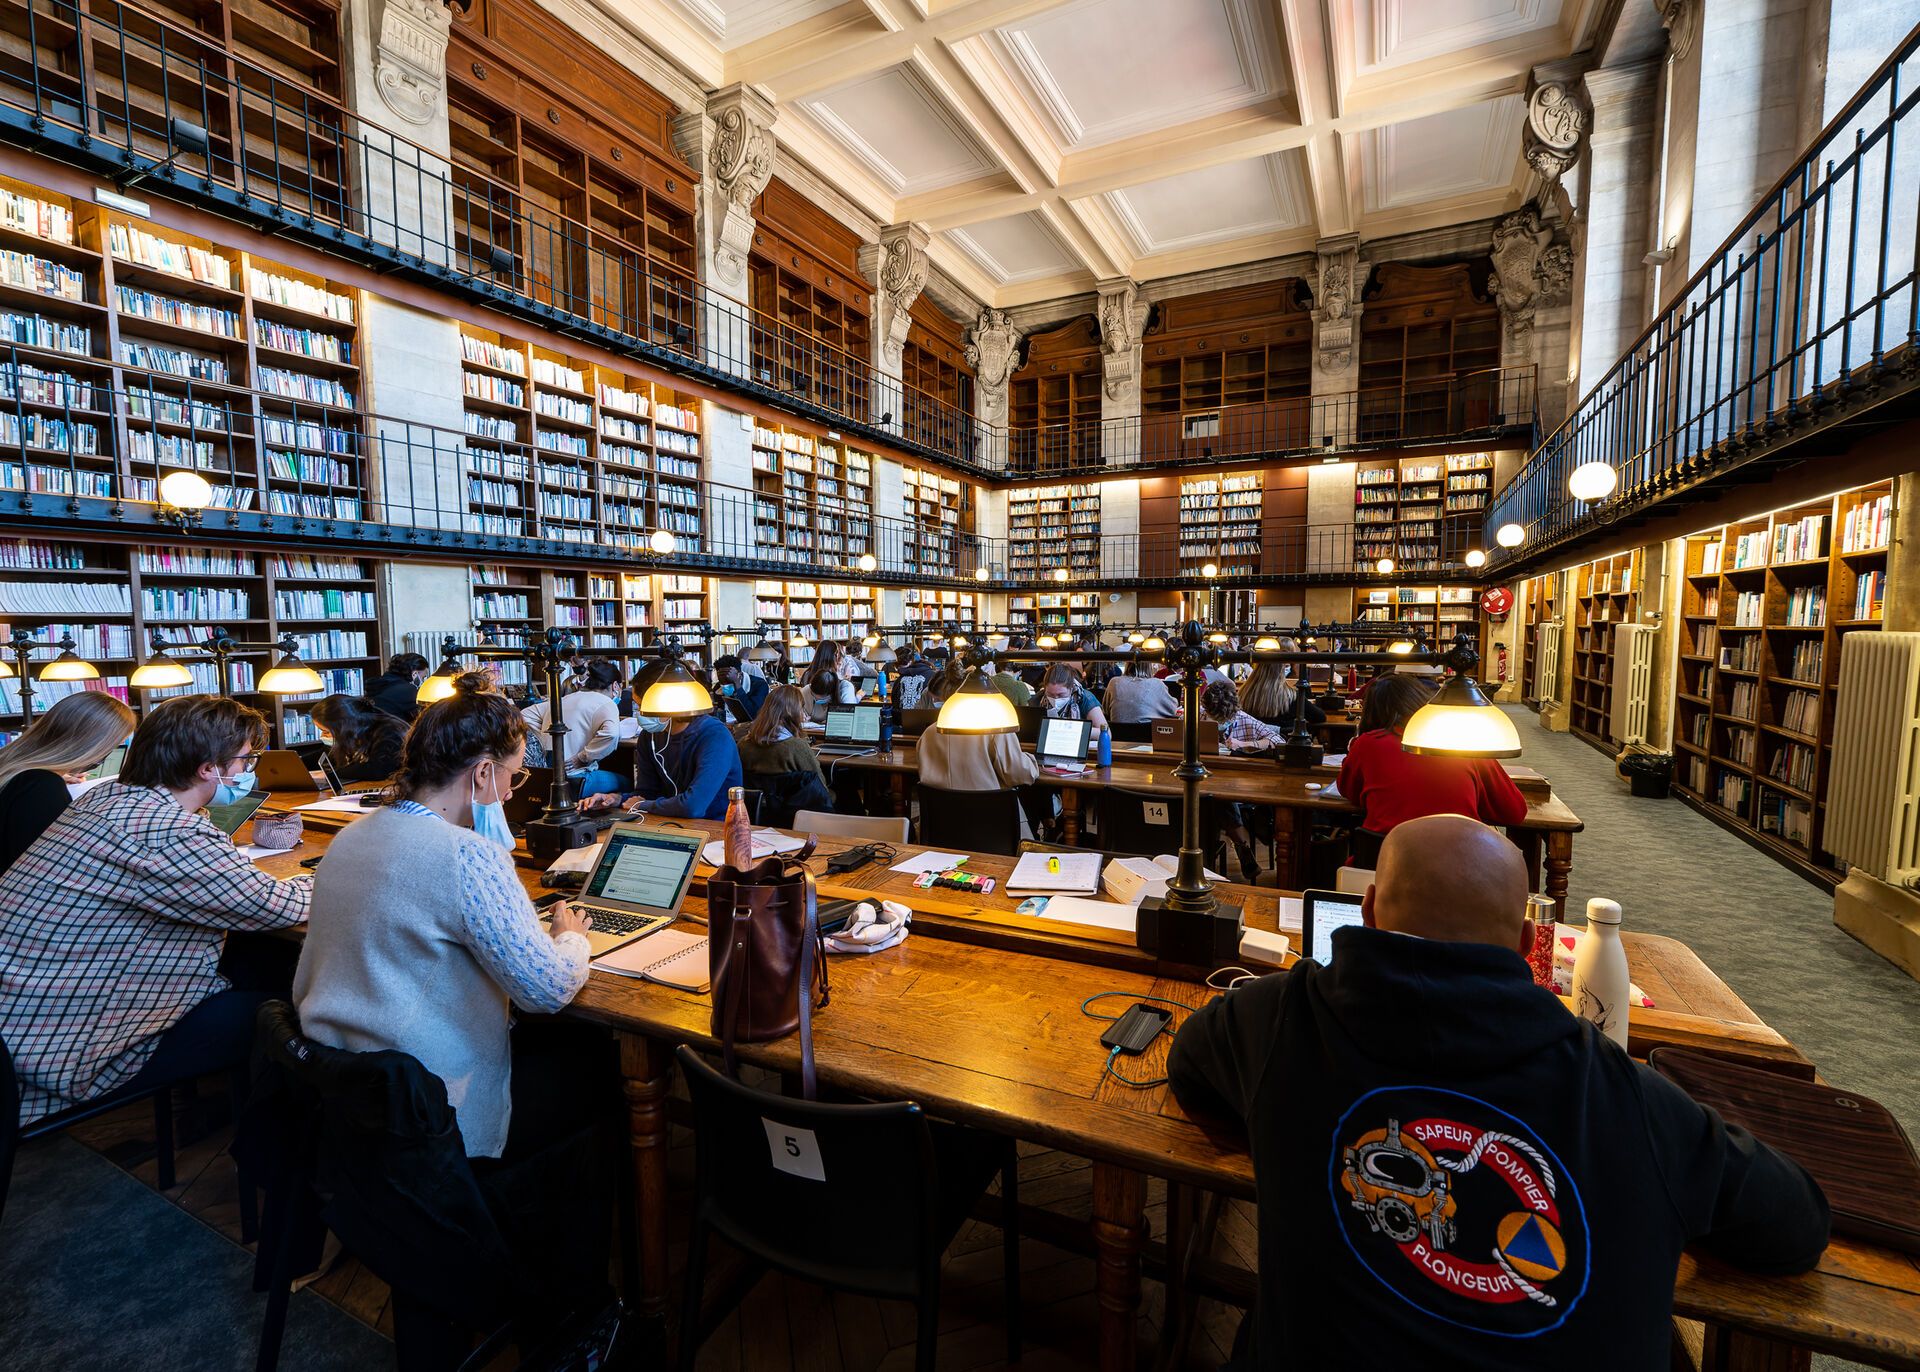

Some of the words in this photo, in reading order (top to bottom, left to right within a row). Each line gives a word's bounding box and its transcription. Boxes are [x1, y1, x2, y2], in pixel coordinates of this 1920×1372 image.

[1148, 807, 1164, 817] 14
[784, 1135, 801, 1158] 5
[1415, 1124, 1474, 1146] SAPEUR
[1485, 1143, 1549, 1212] POMPIER
[1412, 1244, 1514, 1294] PLONGEUR
